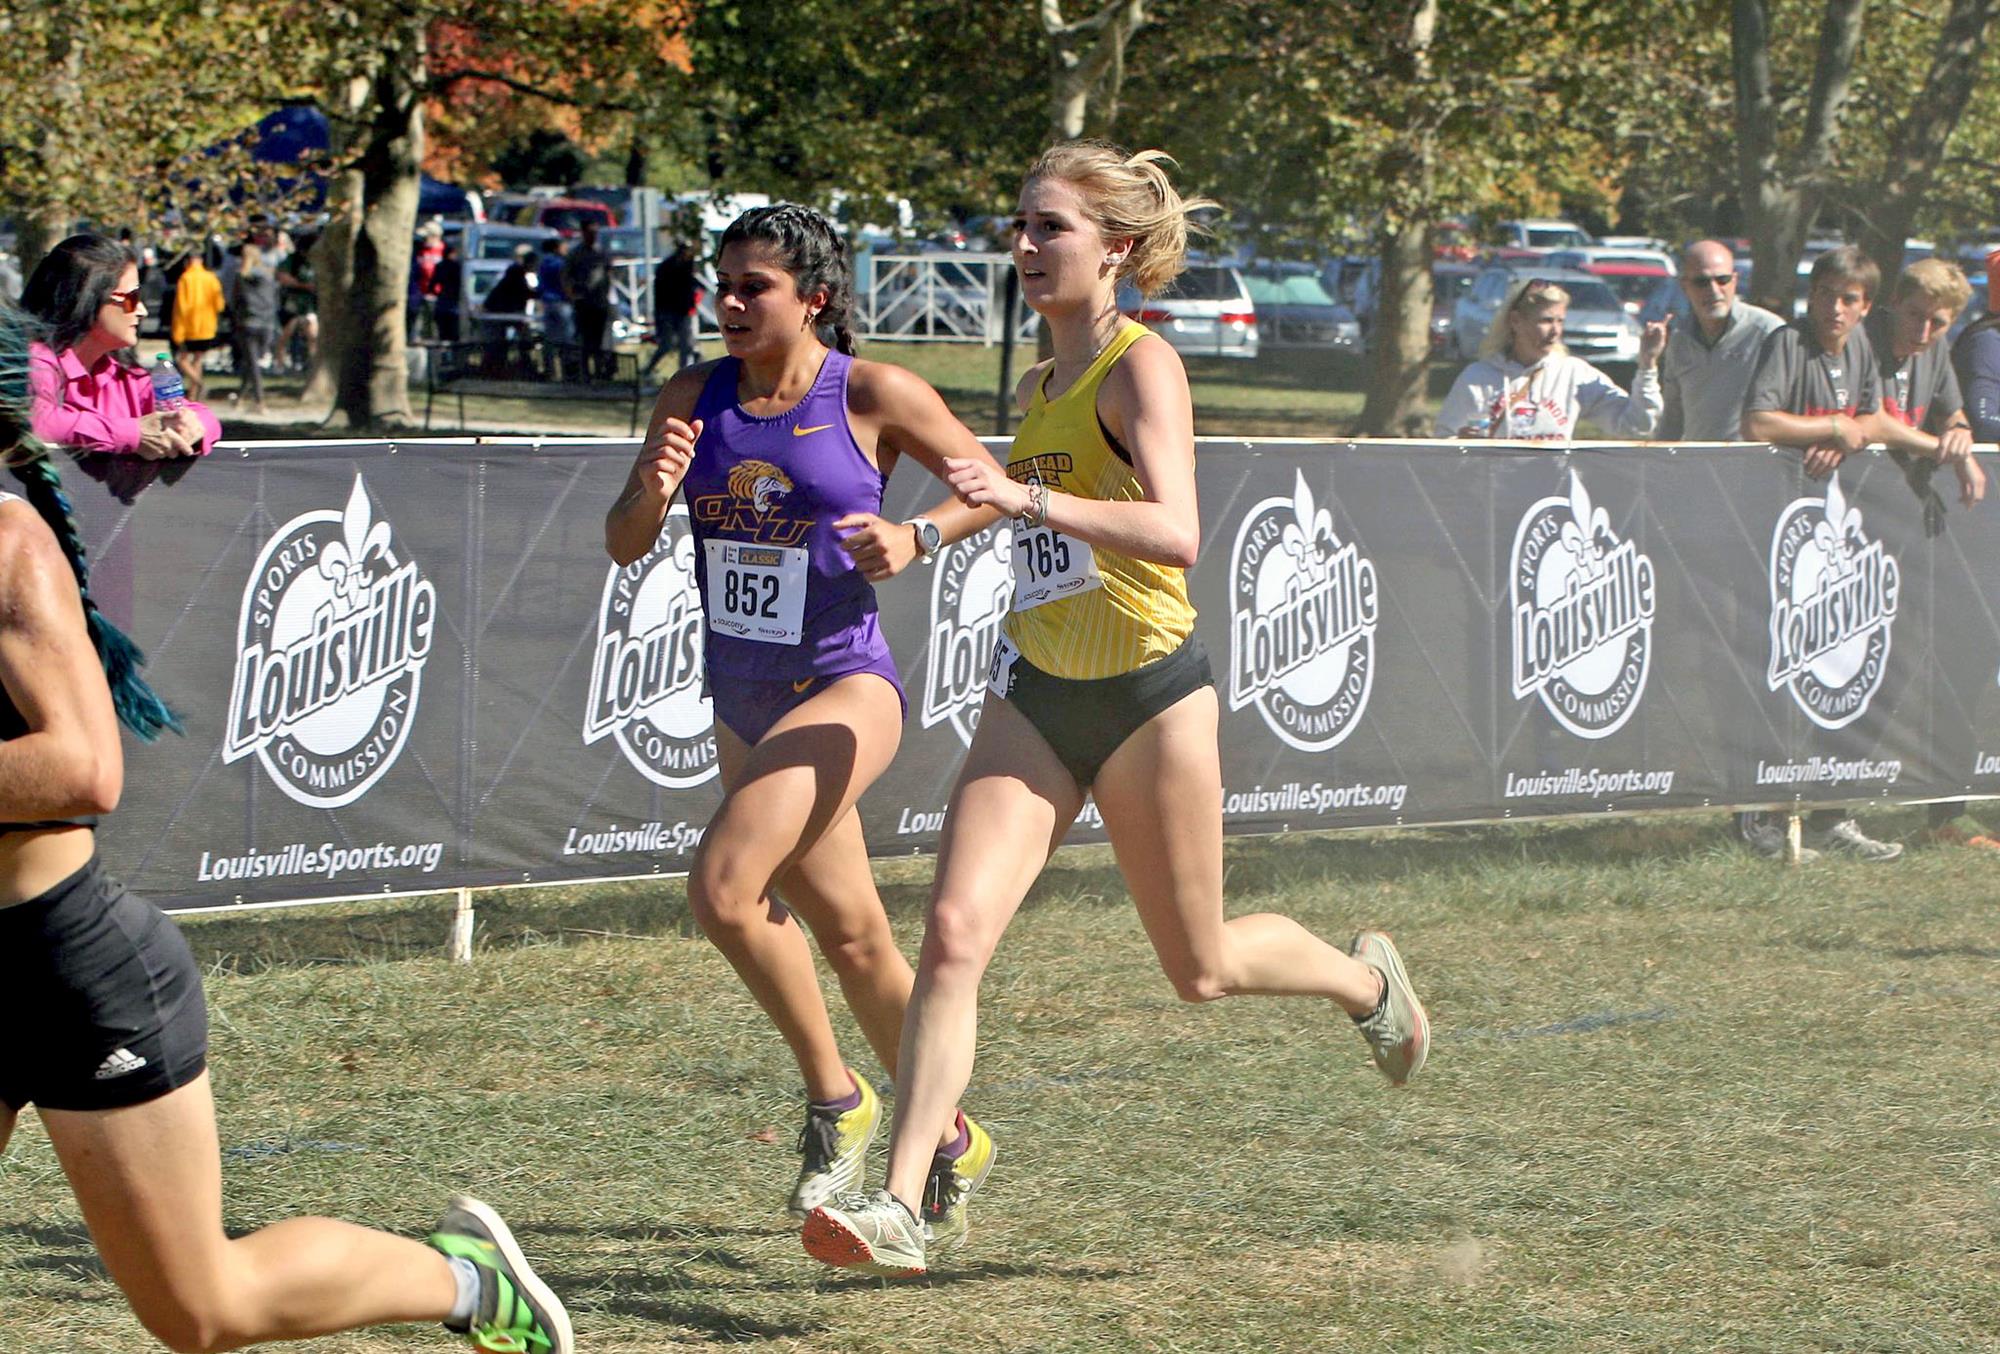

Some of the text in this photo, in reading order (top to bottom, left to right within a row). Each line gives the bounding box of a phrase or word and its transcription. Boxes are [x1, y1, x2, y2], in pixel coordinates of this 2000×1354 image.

[695, 494, 816, 547] ONU
[1017, 529, 1070, 583] 765
[1240, 515, 1281, 597] SPORTS
[1520, 513, 1559, 591] SPORTS
[1778, 513, 1813, 588] SPORTS
[254, 532, 318, 629] SPORTS
[724, 569, 780, 620] 852
[1514, 540, 1655, 692] Louisville
[1769, 540, 1899, 684] Louisville
[226, 561, 436, 758] Louisville
[1232, 542, 1378, 702] Louisville
[588, 590, 704, 738] Louis
[1270, 649, 1367, 736] COMMISSION
[1552, 640, 1644, 724] COMMISSION
[1800, 637, 1884, 714] COMMISSION
[276, 688, 408, 790] COMMISSION
[633, 723, 718, 770] COMMIS
[1755, 755, 1902, 786] LouisvilleSports.org
[1504, 767, 1675, 798] LouisvilleSports.org
[198, 842, 444, 882] LouisvilleSports.org
[563, 821, 707, 855] LouisvilleSp
